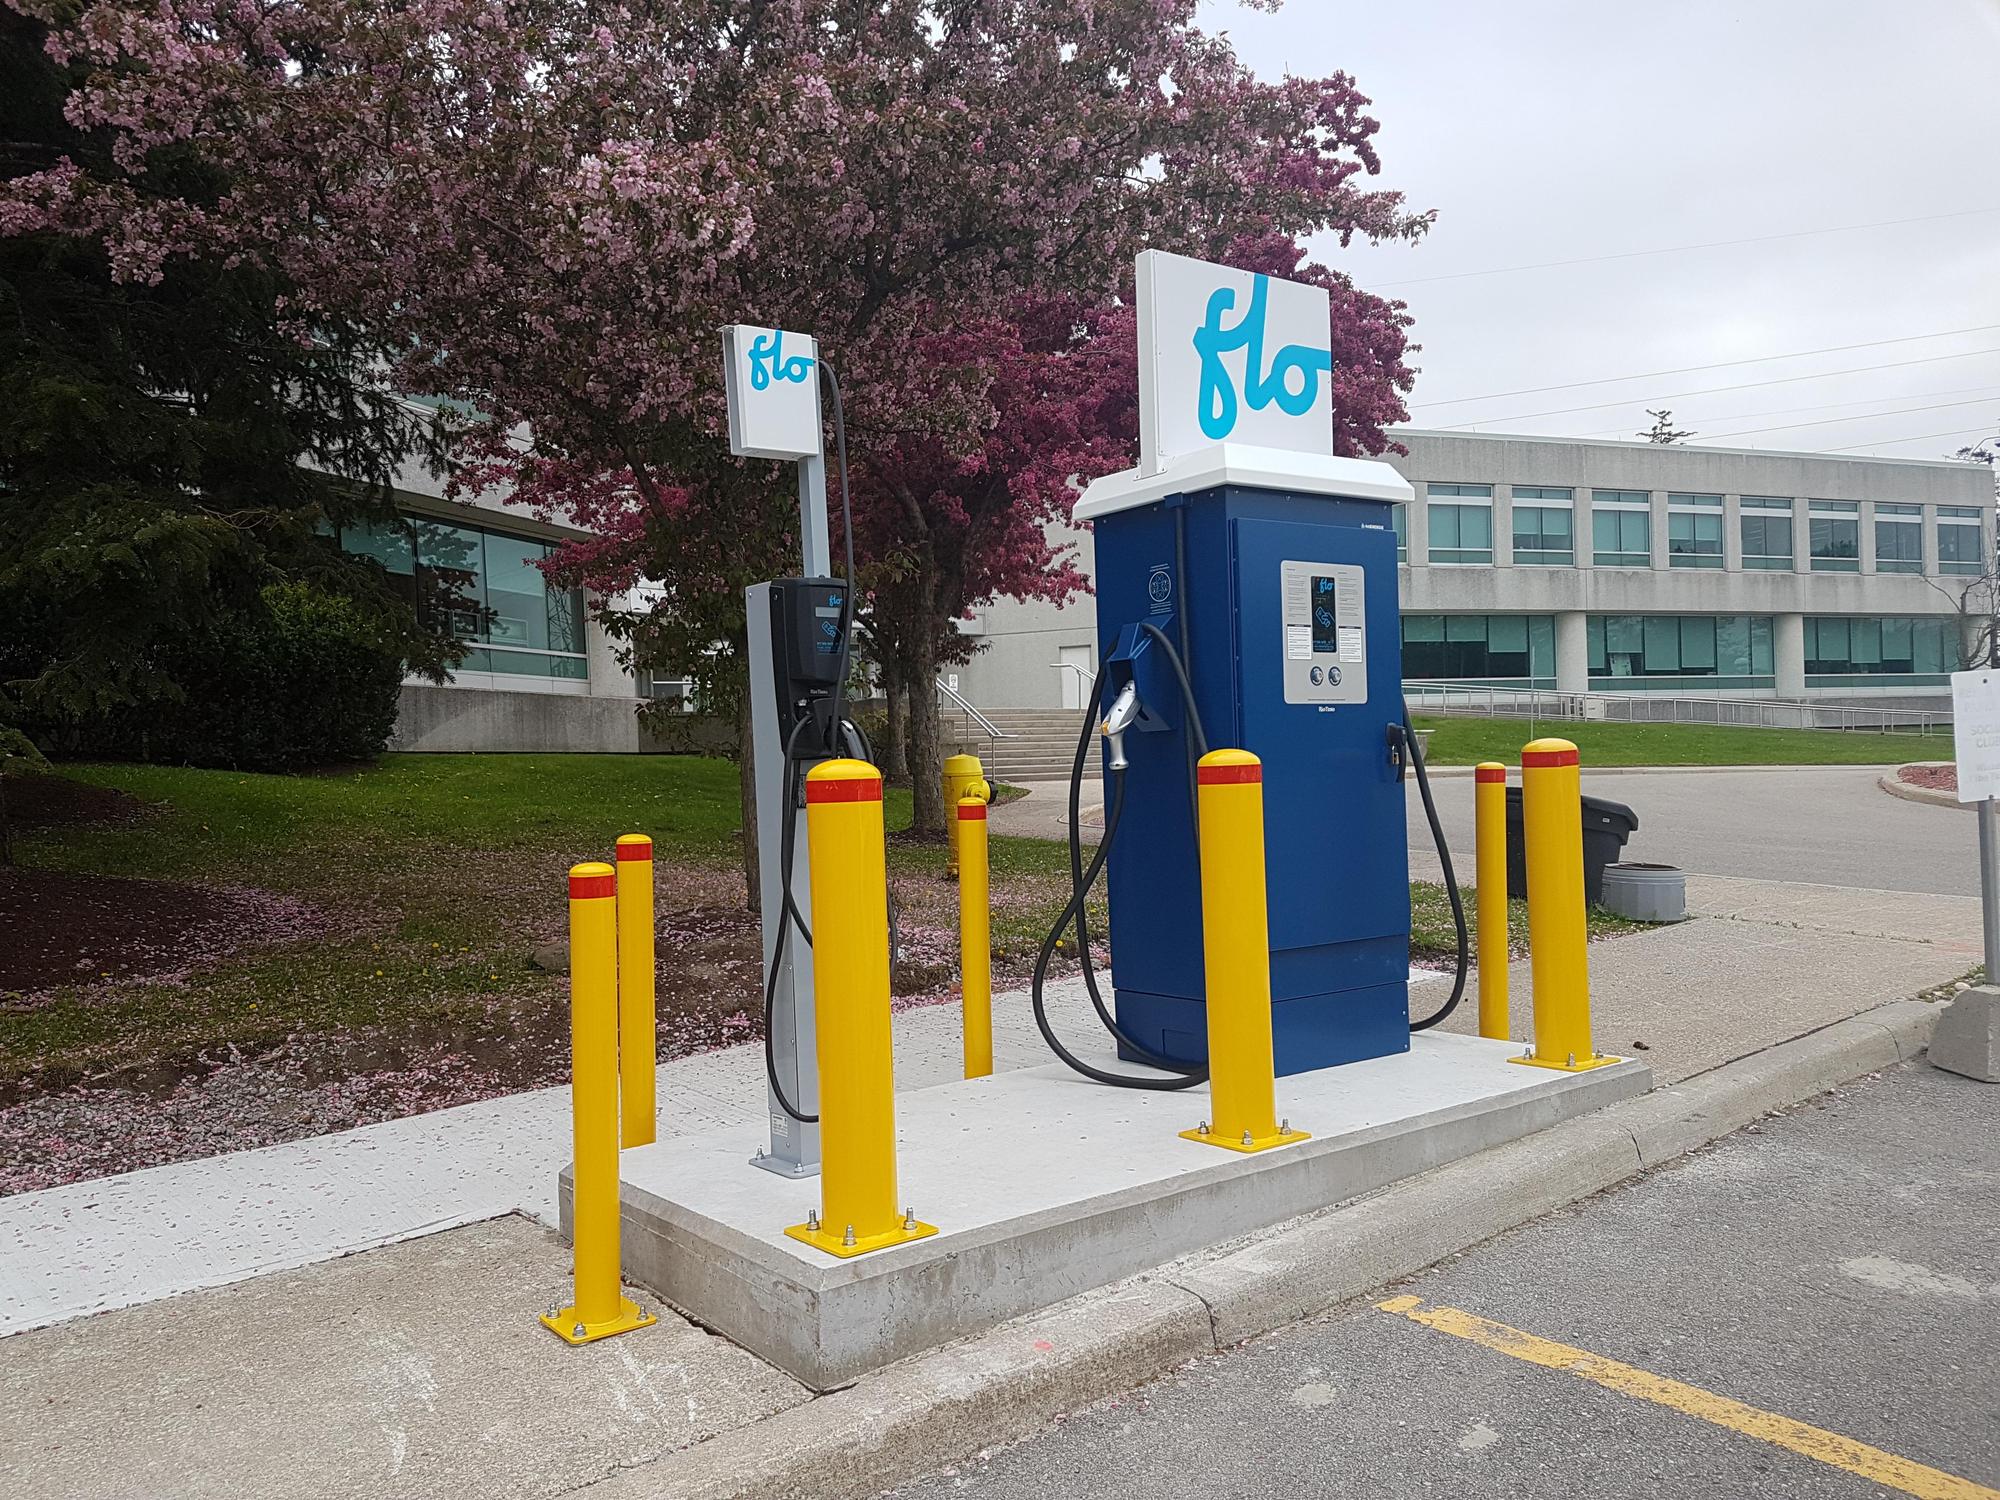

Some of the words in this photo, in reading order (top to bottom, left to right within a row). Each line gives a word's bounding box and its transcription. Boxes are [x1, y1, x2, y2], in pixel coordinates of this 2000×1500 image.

[748, 328, 816, 391] flo
[1192, 272, 1332, 440] flo
[829, 594, 843, 607] flo
[1320, 577, 1334, 593] flo
